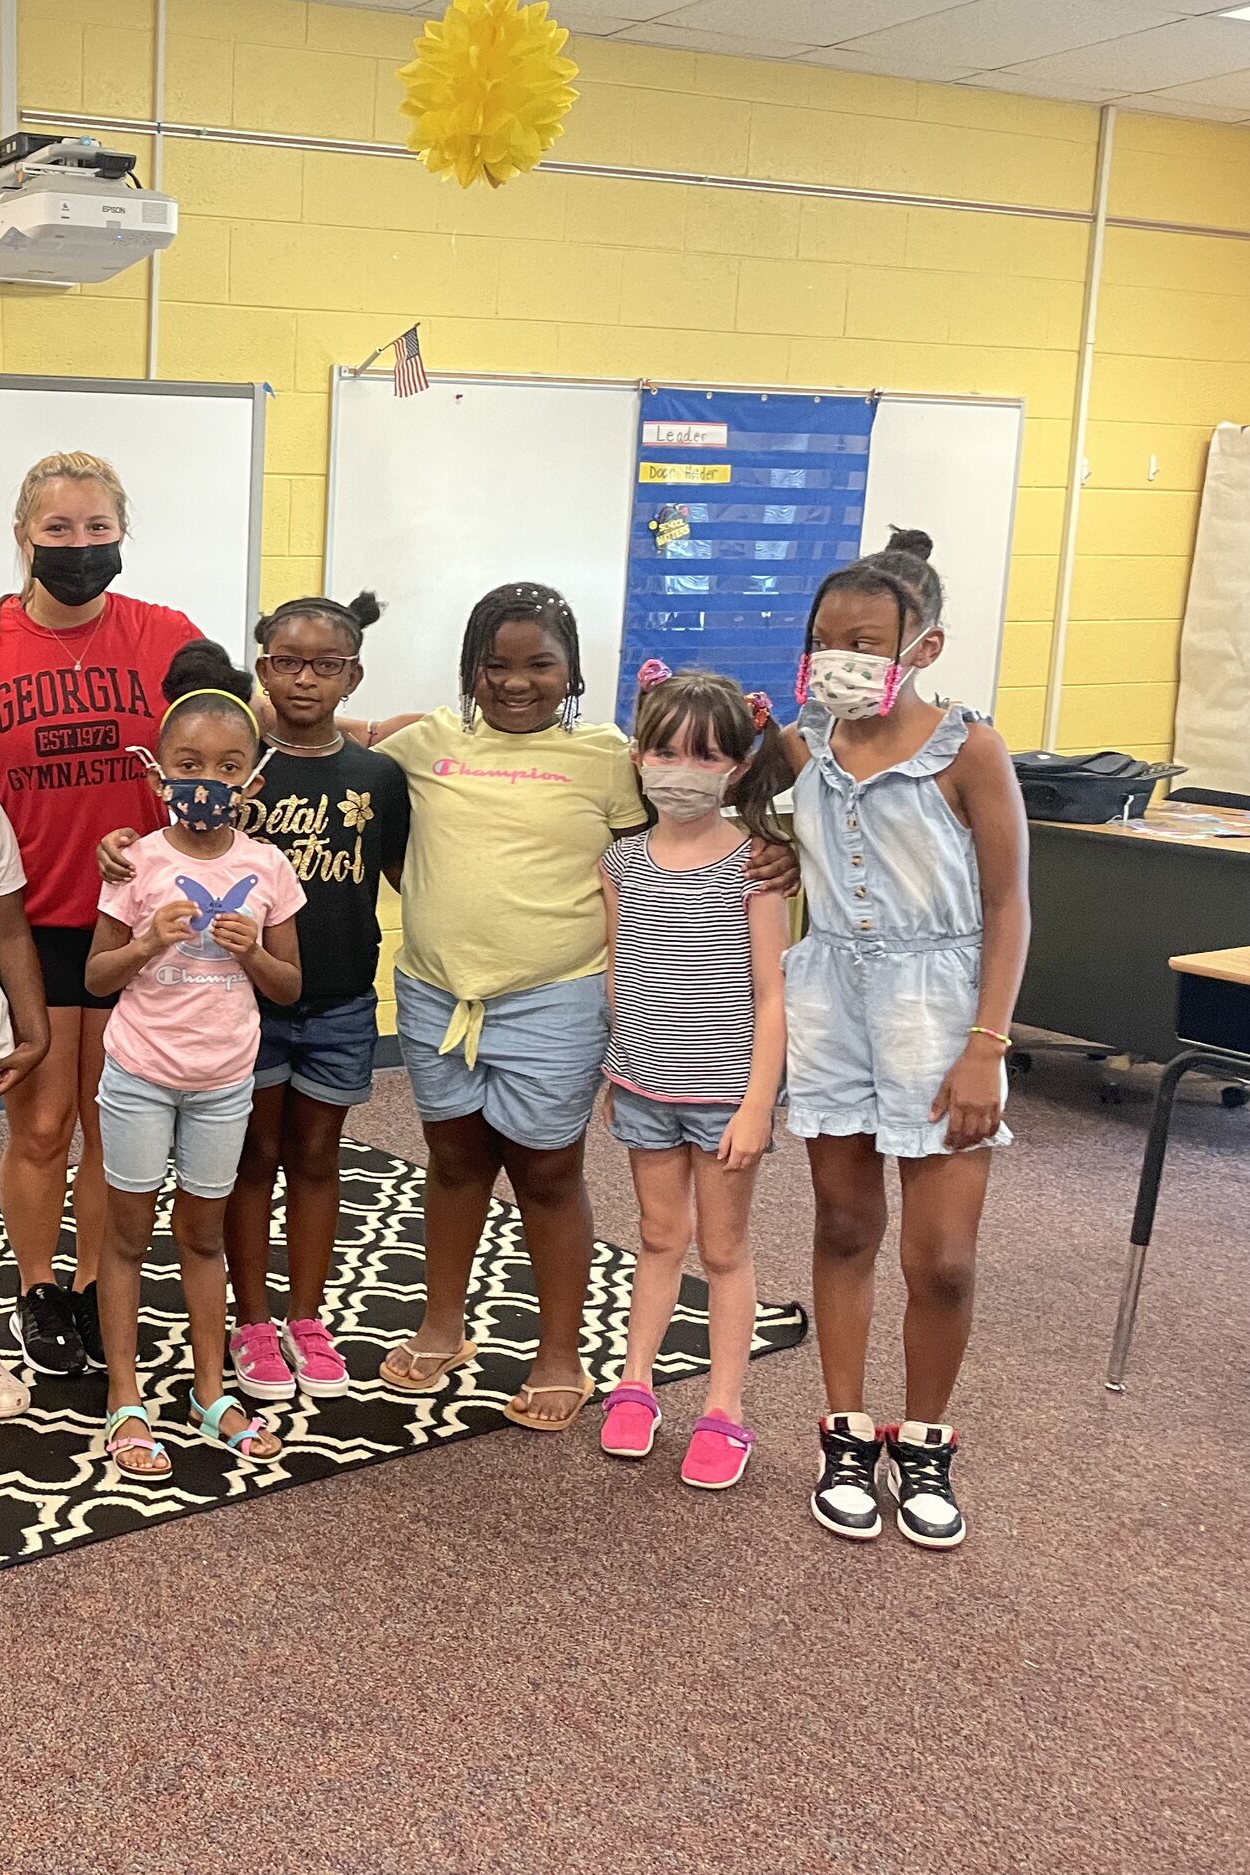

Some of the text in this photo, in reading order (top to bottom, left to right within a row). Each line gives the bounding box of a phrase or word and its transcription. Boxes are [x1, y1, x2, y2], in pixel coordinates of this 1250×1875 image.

[102, 205, 126, 214] EPSON
[656, 425, 708, 442] Leader
[76, 725, 117, 749] 1973
[432, 758, 573, 785] Champion
[283, 833, 366, 885] atrol
